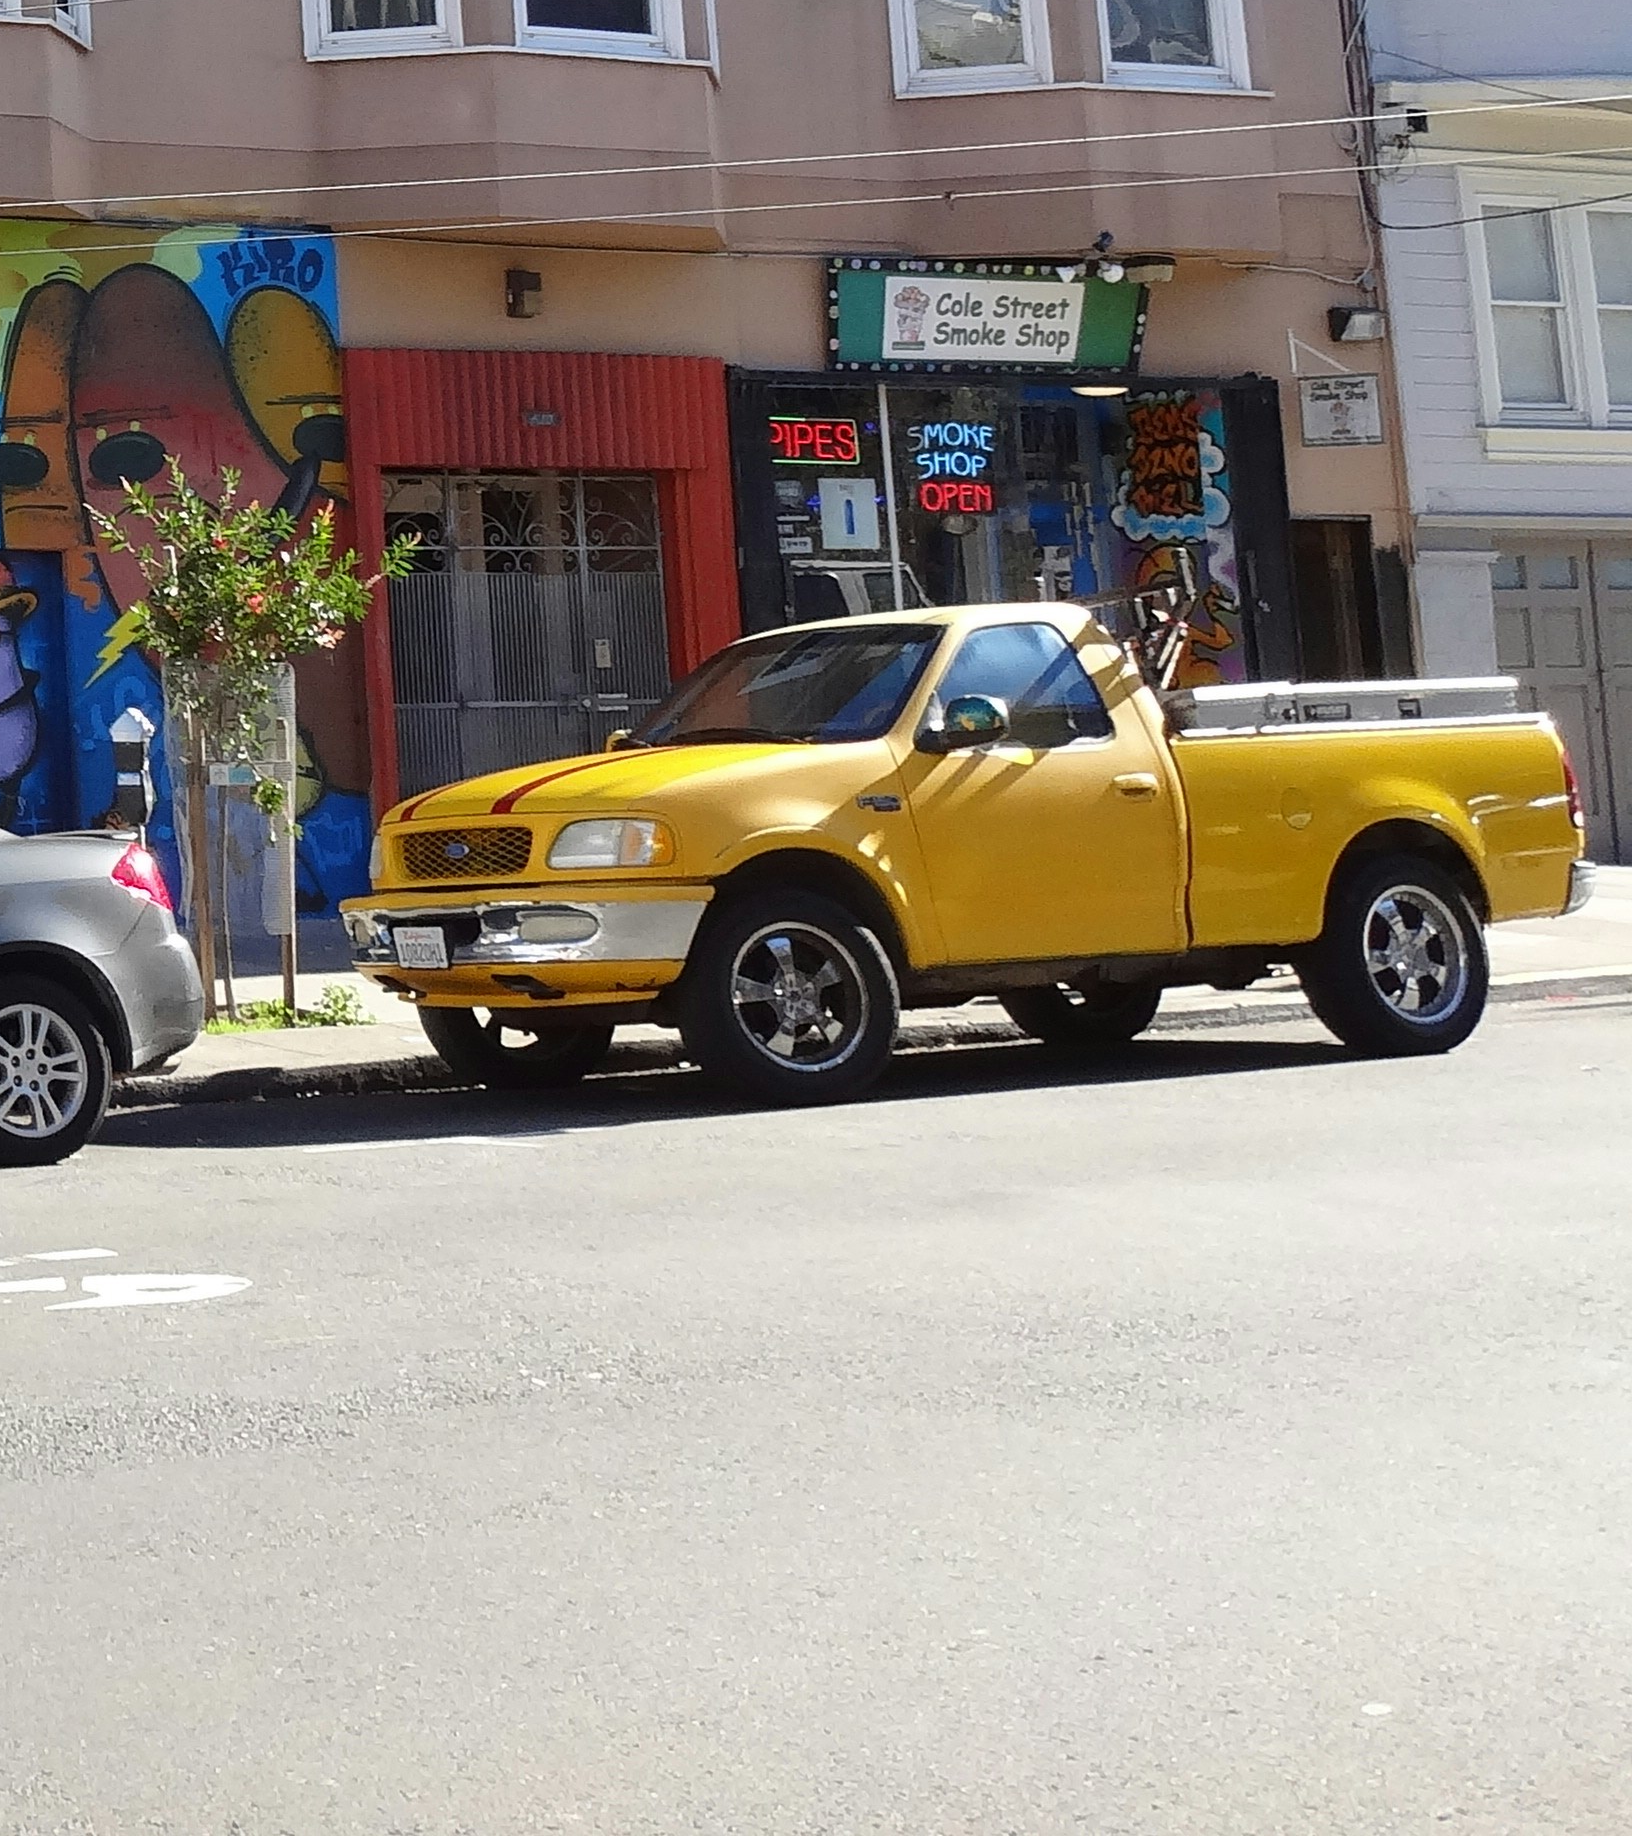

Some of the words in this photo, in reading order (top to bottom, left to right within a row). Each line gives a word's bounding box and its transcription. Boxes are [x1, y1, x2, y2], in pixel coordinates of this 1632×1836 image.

[936, 292, 983, 317] Cole
[993, 295, 1071, 320] Street
[933, 322, 1006, 346] Smoke
[1015, 323, 1070, 355] Shop
[907, 422, 994, 453] SMOKE
[916, 451, 987, 480] SHOP
[919, 482, 994, 512] OPEN
